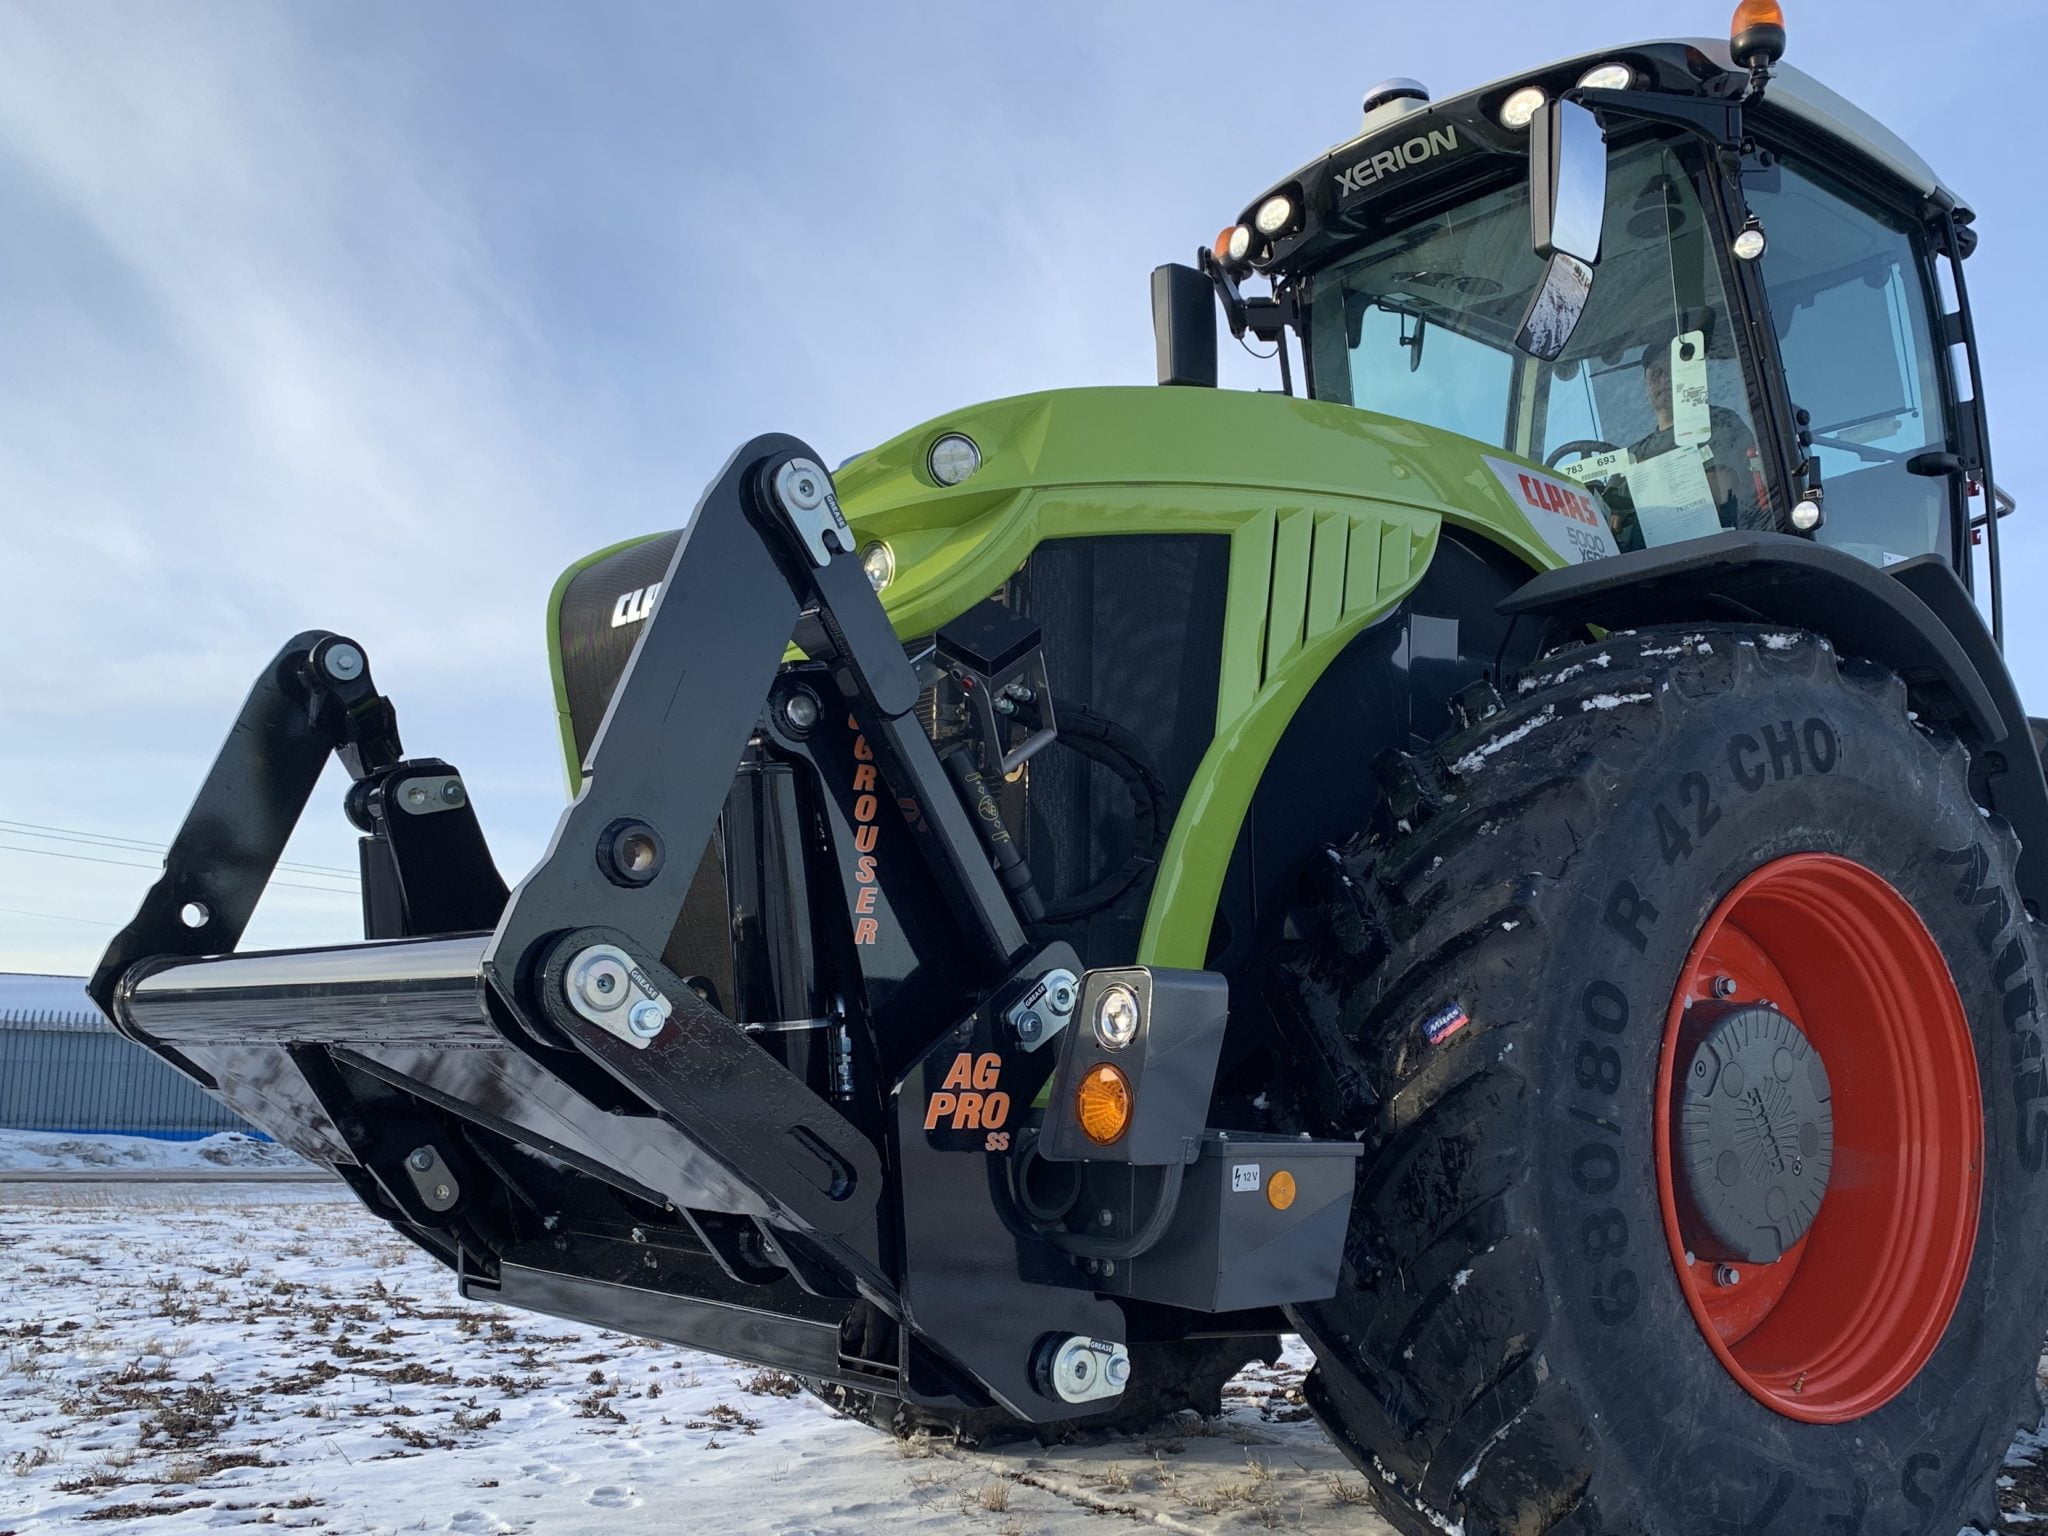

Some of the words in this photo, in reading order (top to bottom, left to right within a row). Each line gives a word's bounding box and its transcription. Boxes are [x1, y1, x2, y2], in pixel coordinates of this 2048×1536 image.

[1334, 125, 1459, 198] XERION
[1565, 464, 1584, 475] 783
[1597, 455, 1616, 467] 693
[826, 495, 846, 528] GREASE
[1517, 473, 1598, 527] CLAAS
[1567, 526, 1605, 553] 5000
[1727, 715, 1843, 794] CHO
[1652, 770, 1722, 867] 42
[1602, 878, 1660, 954] R
[631, 970, 657, 998] GREASE
[1025, 984, 1046, 1007] GREASE
[941, 1052, 1001, 1090] AG
[923, 1091, 1011, 1130] PRO
[985, 1132, 1010, 1151] SS
[1570, 978, 1643, 1328] 680/80
[1090, 1341, 1113, 1352] GREASE
